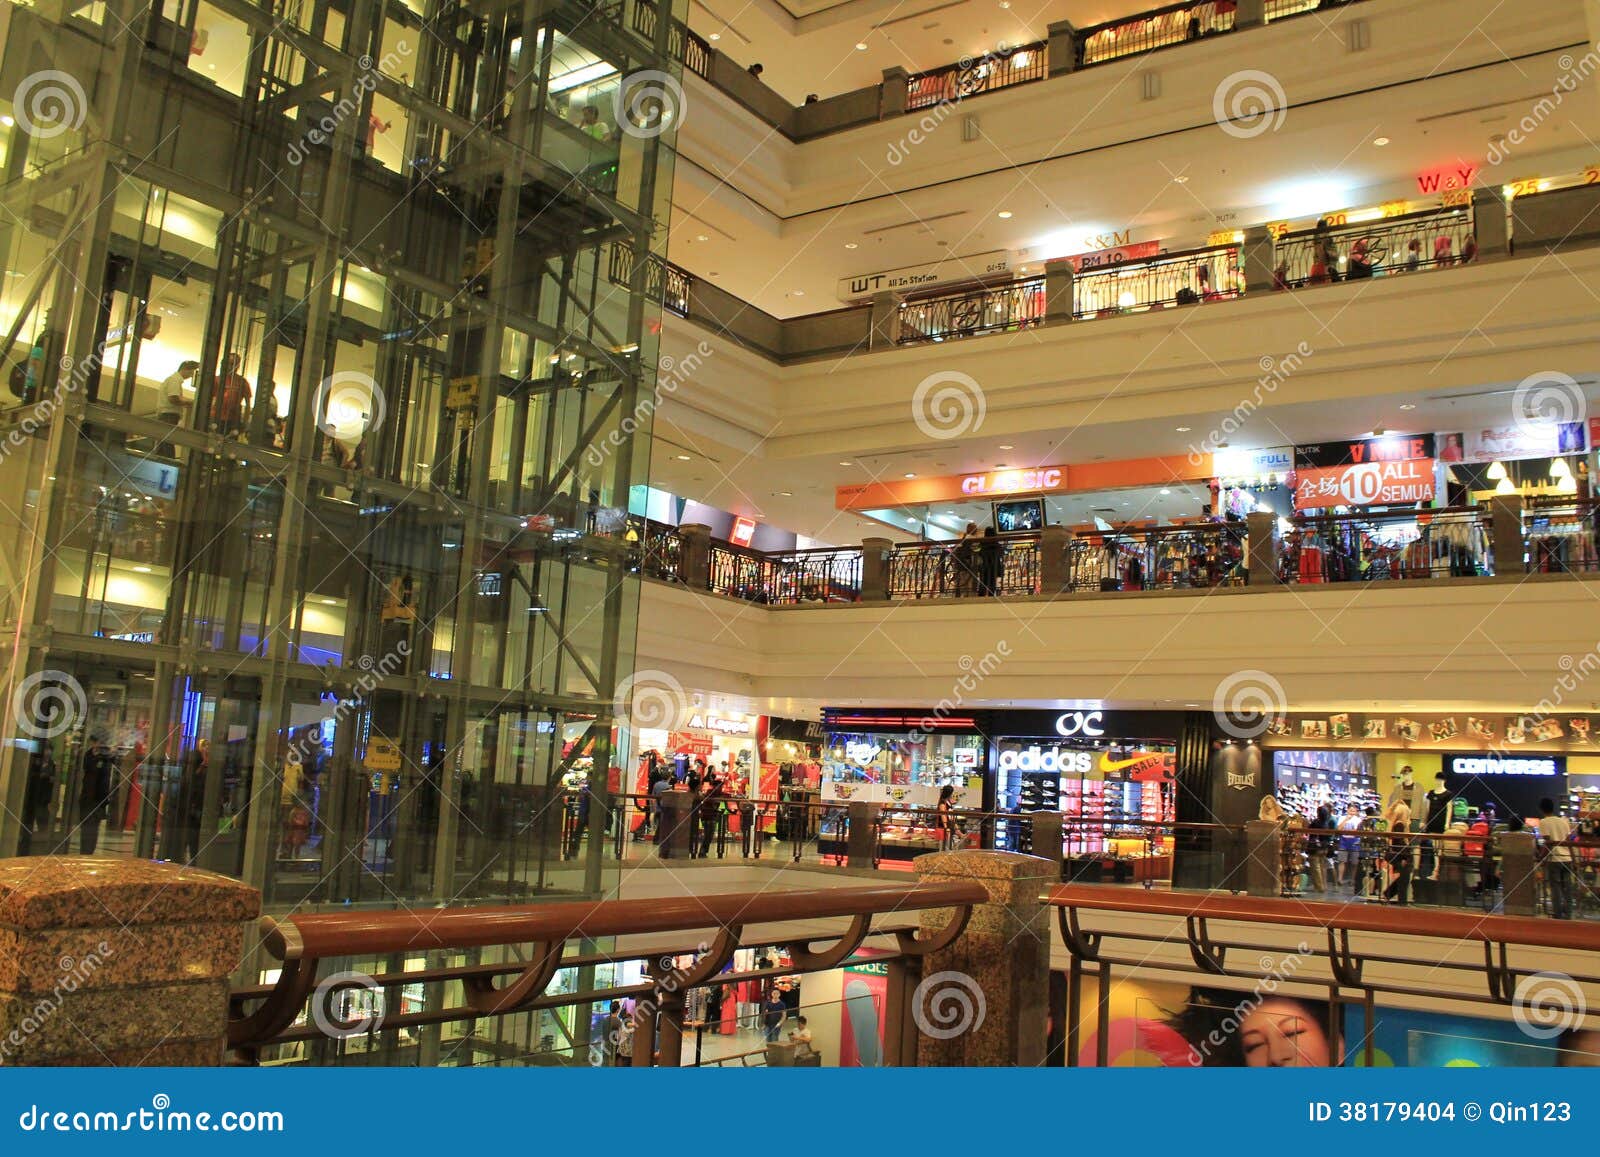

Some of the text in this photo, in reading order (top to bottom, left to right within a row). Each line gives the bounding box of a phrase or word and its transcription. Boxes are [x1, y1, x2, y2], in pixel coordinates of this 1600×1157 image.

[1418, 174, 1440, 193] W
[1458, 168, 1473, 186] Y
[1299, 461, 1420, 500] 全场 10 ALL
[1381, 484, 1433, 502] SEMUA
[999, 746, 1091, 773] adidas
[1453, 758, 1556, 775] CONVERSE
